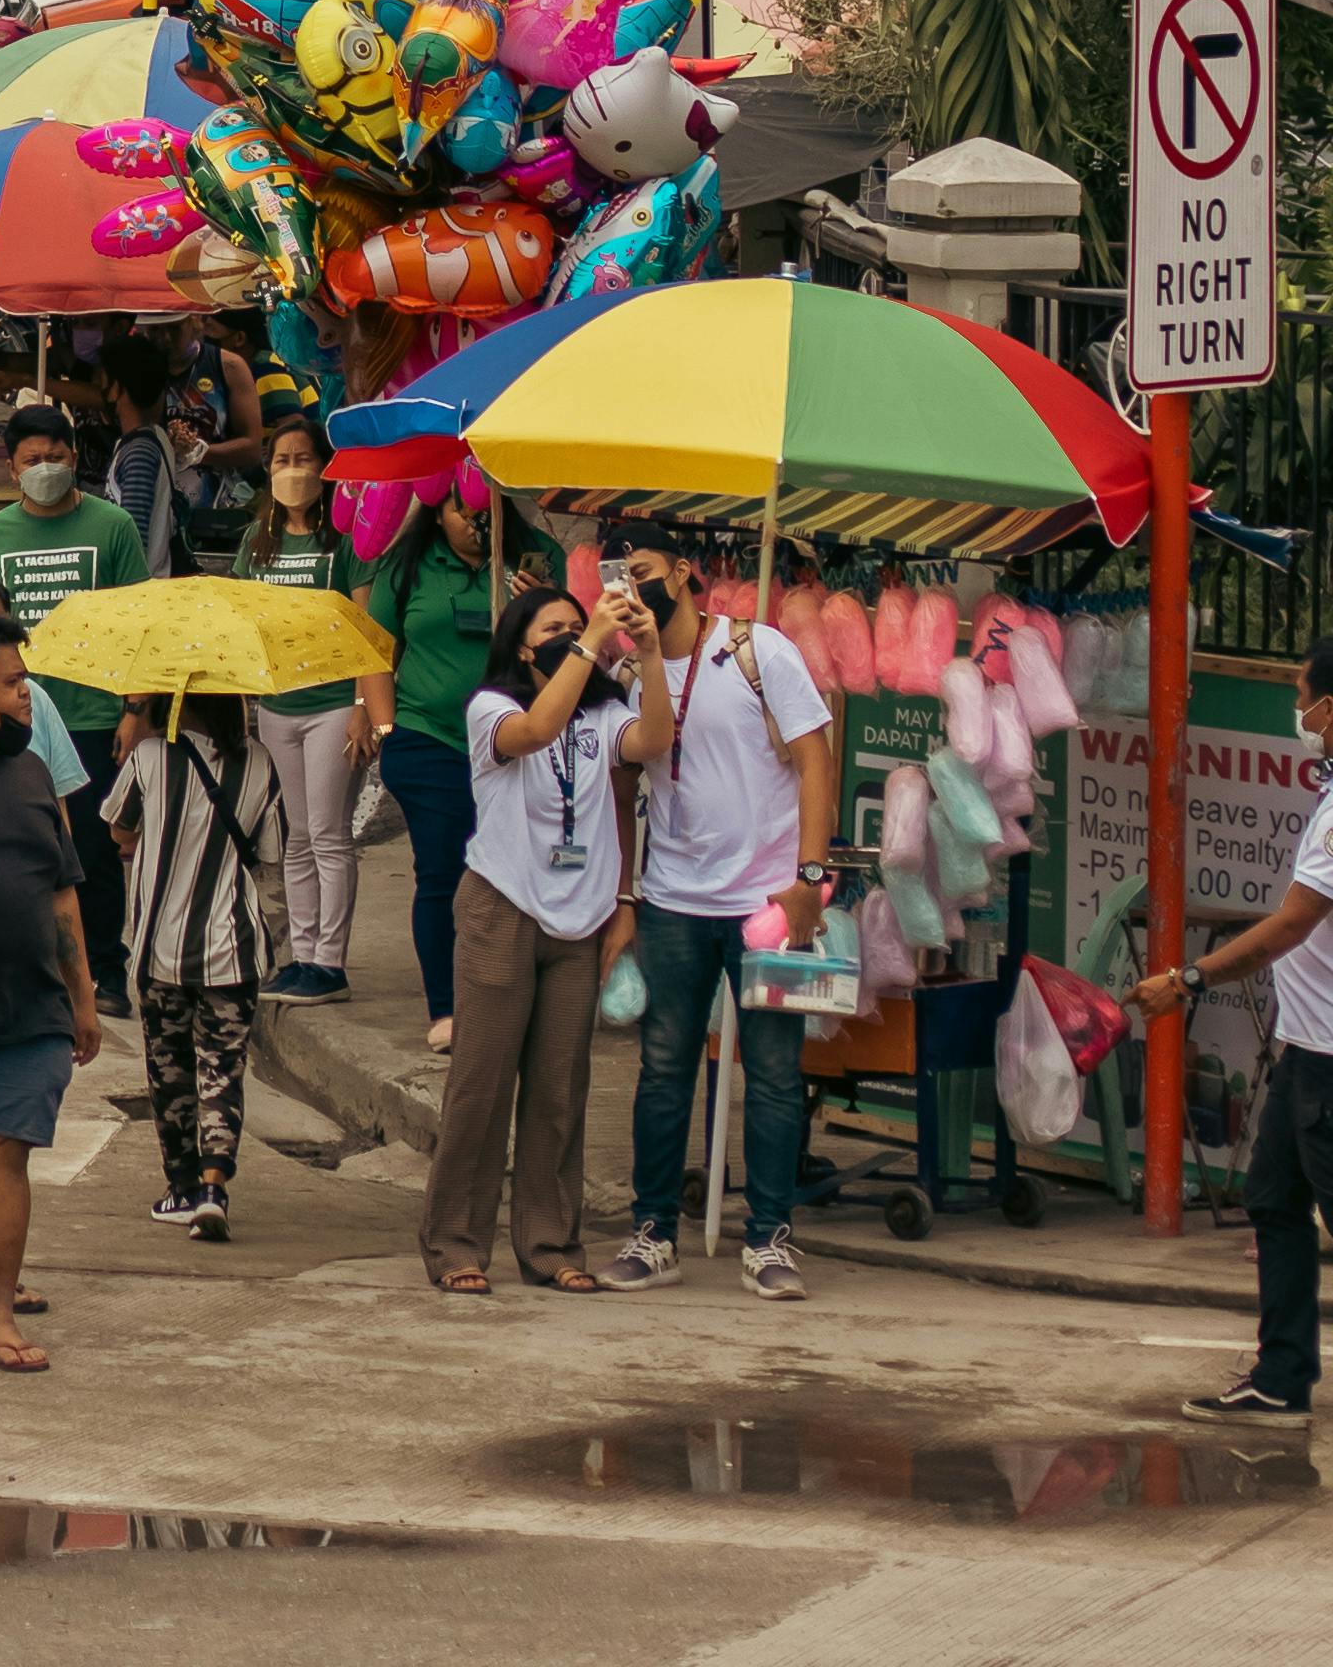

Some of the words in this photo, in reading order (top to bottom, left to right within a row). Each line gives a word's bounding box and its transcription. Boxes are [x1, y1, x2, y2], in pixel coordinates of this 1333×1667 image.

[1181, 198, 1228, 244] NO
[1157, 256, 1252, 306] RIGHT
[1159, 319, 1246, 368] TURN
[24, 552, 81, 567] FACEMASK
[271, 558, 318, 569] ACEMASK
[23, 570, 81, 584] DISTANSYA
[896, 707, 933, 729] MAY
[864, 726, 923, 751] DAPAT
[1080, 776, 1117, 808] Do
[1189, 798, 1257, 828] eave
[1196, 829, 1292, 874] Penalty:
[1242, 880, 1272, 905] or
